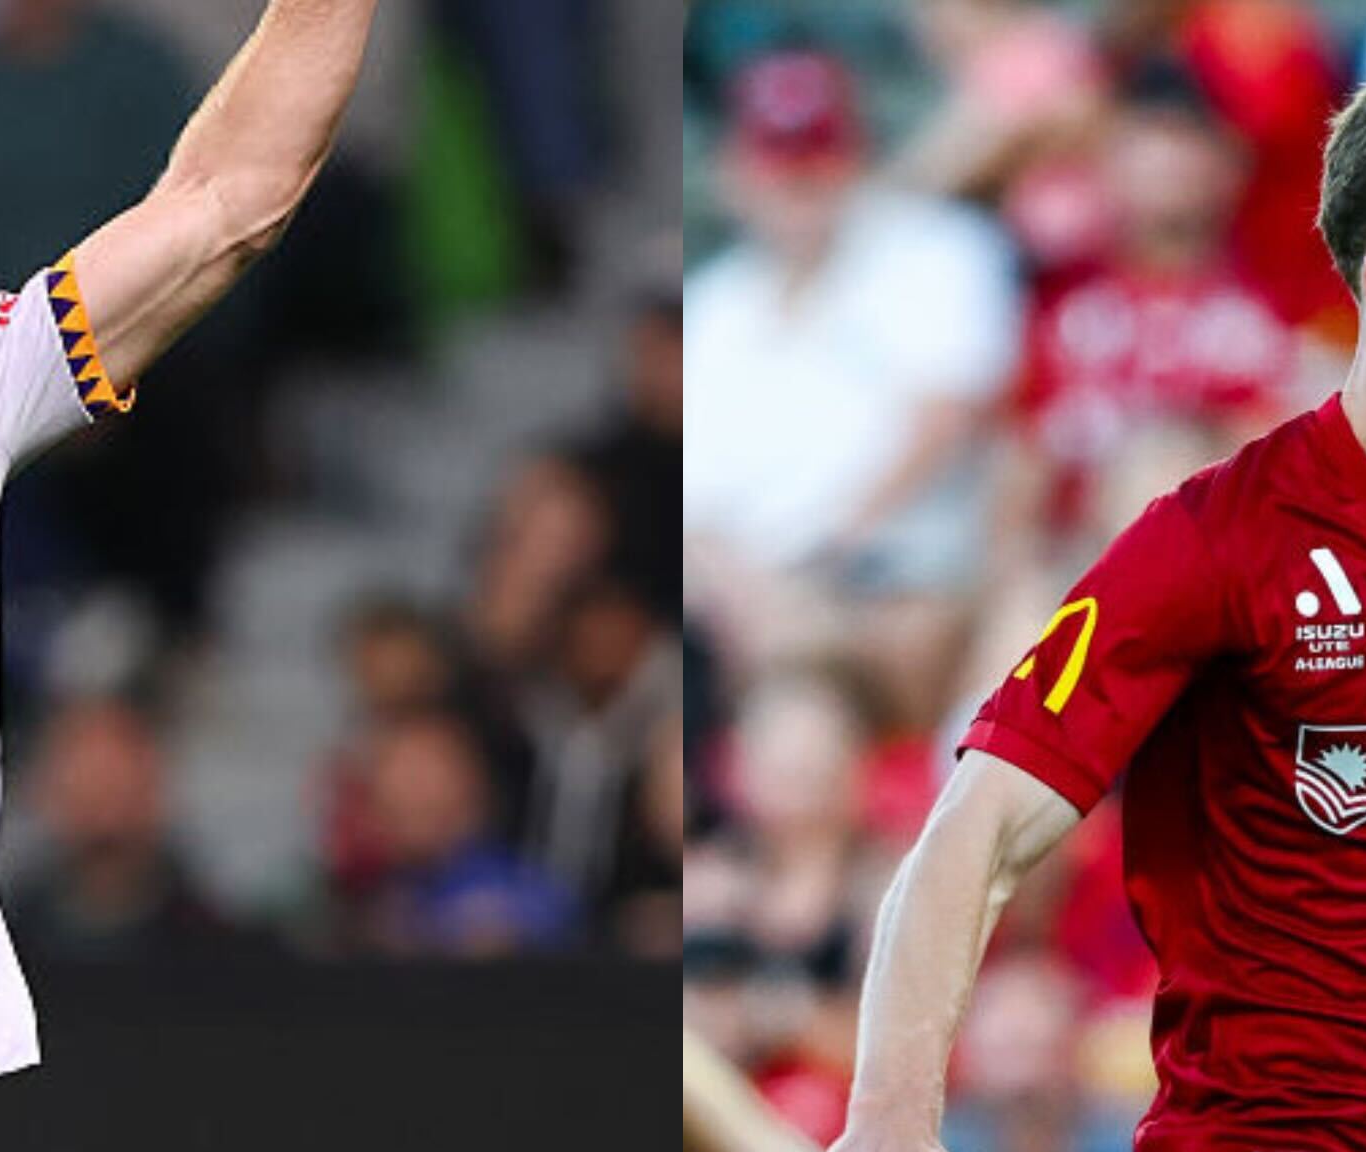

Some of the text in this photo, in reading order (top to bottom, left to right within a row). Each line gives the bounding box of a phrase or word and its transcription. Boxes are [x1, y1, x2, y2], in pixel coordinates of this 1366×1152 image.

[1295, 622, 1365, 641] ISUZU
[1308, 641, 1351, 653] UTE
[1295, 654, 1365, 672] A-LEAGUE
